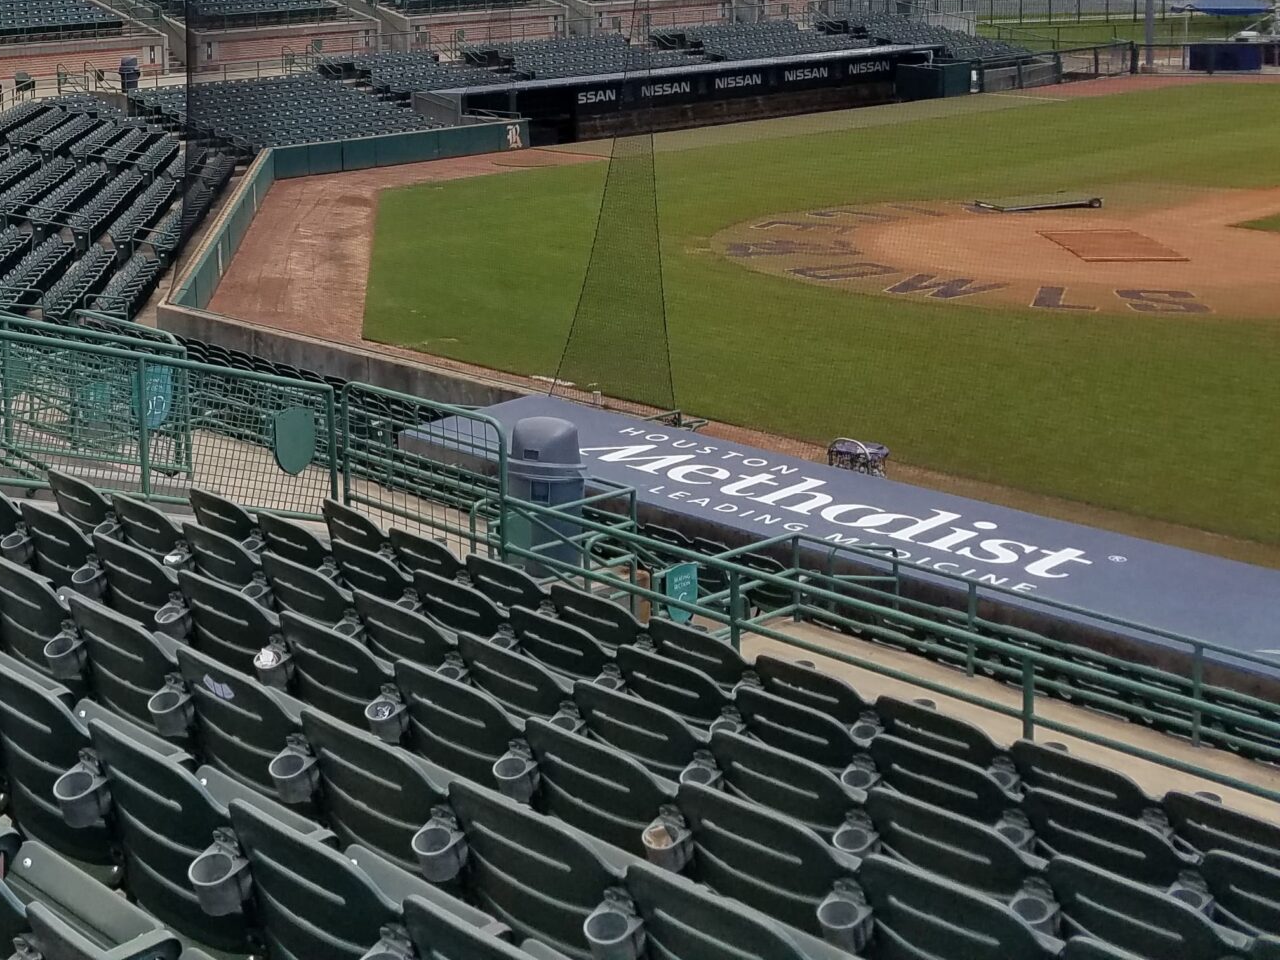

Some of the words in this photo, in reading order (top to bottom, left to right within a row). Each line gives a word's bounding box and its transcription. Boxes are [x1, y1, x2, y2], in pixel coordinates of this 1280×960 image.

[784, 67, 828, 82] NISSAN
[848, 60, 891, 75] NISSAN
[640, 81, 691, 97] NISSAN
[714, 73, 762, 89] NISSAN
[577, 89, 616, 104] SSAN
[784, 262, 1217, 313] OWLS
[618, 427, 800, 475] HOUSTON
[579, 444, 1094, 578] Methodist
[647, 485, 809, 532] LEADING
[823, 533, 1037, 593] MDICINE
